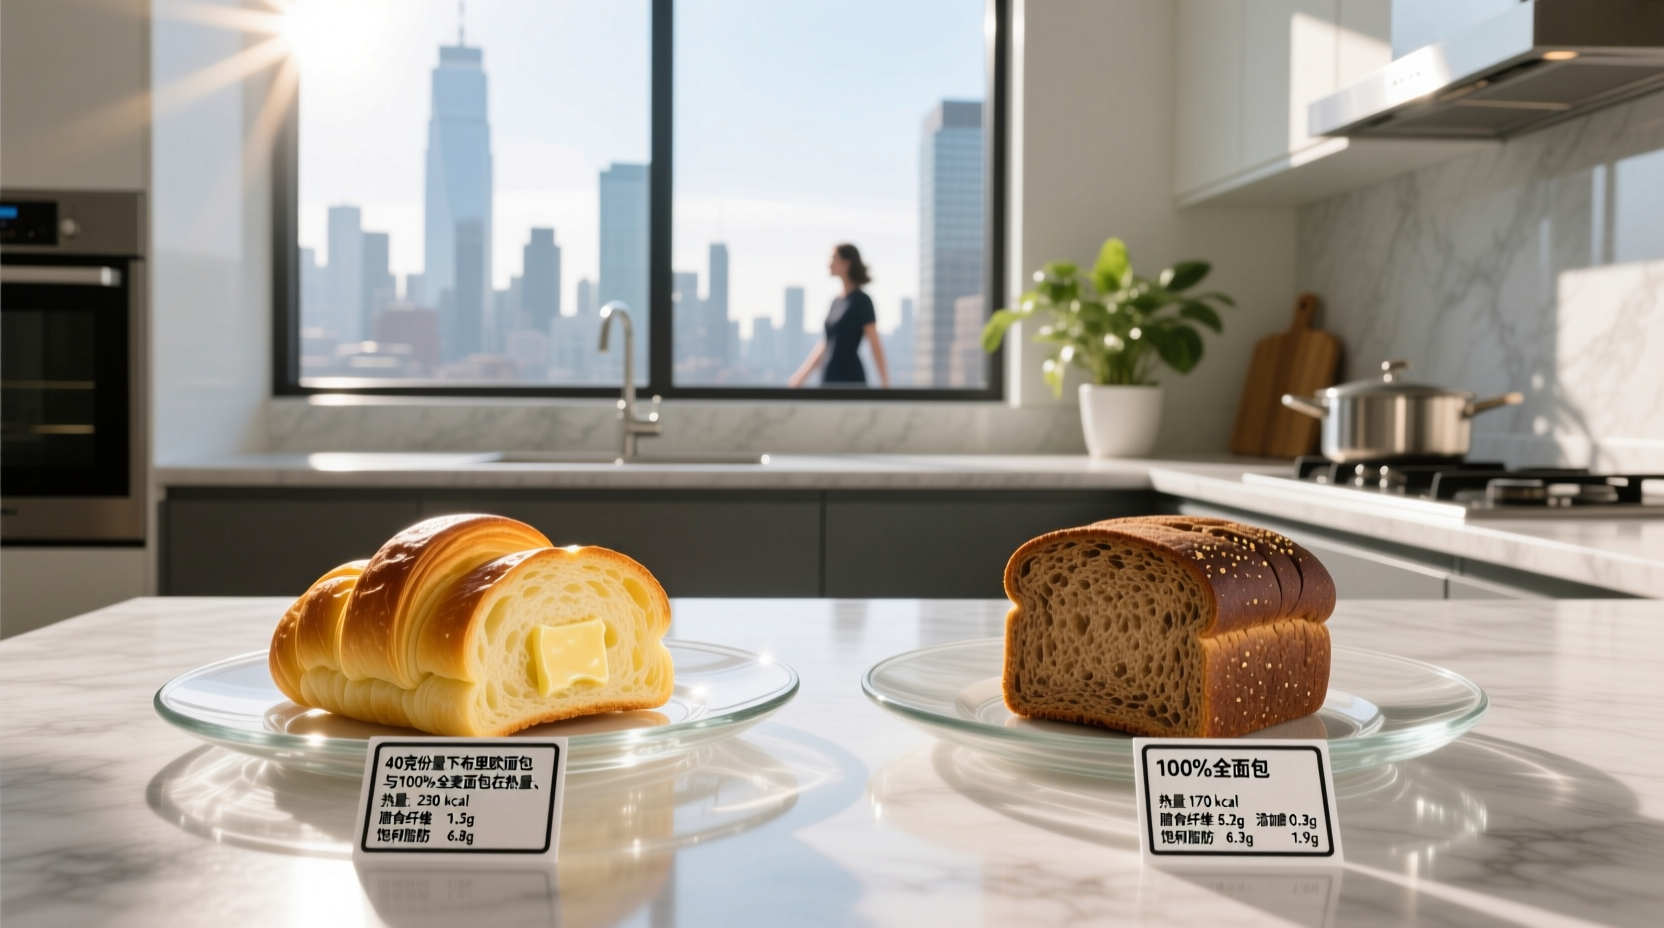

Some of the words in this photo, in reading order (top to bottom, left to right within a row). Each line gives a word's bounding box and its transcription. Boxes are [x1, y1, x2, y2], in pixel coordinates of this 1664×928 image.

[1156, 758, 1270, 778] 100%全面包
[417, 794, 440, 806] 230
[445, 794, 470, 806] kcal
[1190, 795, 1212, 808] 170
[1215, 794, 1238, 808] kcal
[447, 812, 474, 827] 1.5g
[1218, 814, 1244, 829] 5.2g
[1289, 814, 1317, 830] 0.3g
[1226, 832, 1254, 847] 6.3g
[1292, 832, 1318, 848] 1.9g
